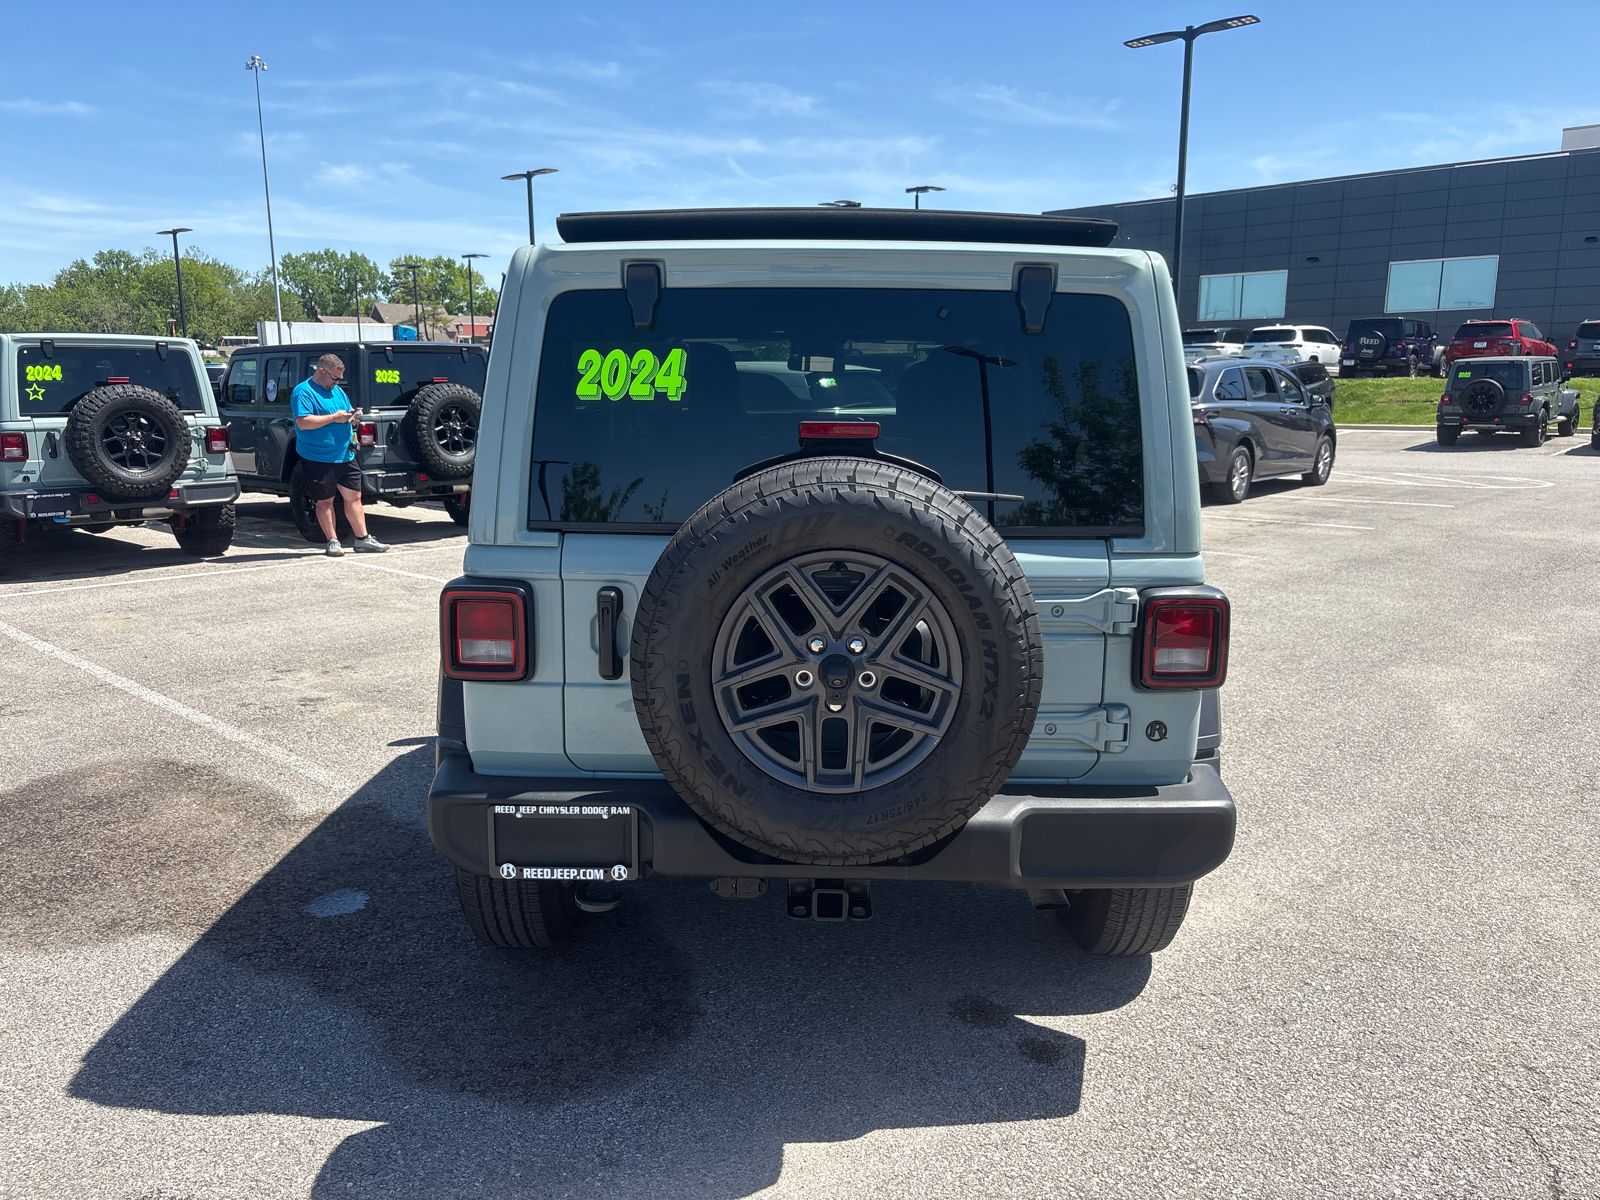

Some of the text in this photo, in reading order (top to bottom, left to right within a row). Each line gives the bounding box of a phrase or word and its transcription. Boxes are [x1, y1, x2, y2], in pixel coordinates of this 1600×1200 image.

[1359, 337, 1380, 345] REED
[26, 365, 62, 381] 2024
[375, 369, 400, 384] 2025
[576, 348, 688, 401] 2024
[707, 534, 769, 589] All-Weather
[734, 542, 772, 570] Performance
[895, 531, 992, 629] ROADIAN
[979, 639, 999, 720] HTX2
[676, 673, 748, 798] NEXEN
[494, 805, 630, 815] REED JEEP CHRYSLER DODGE RAM
[866, 791, 928, 825] 245/75R17
[523, 868, 604, 880] REEDJEEP.COM
